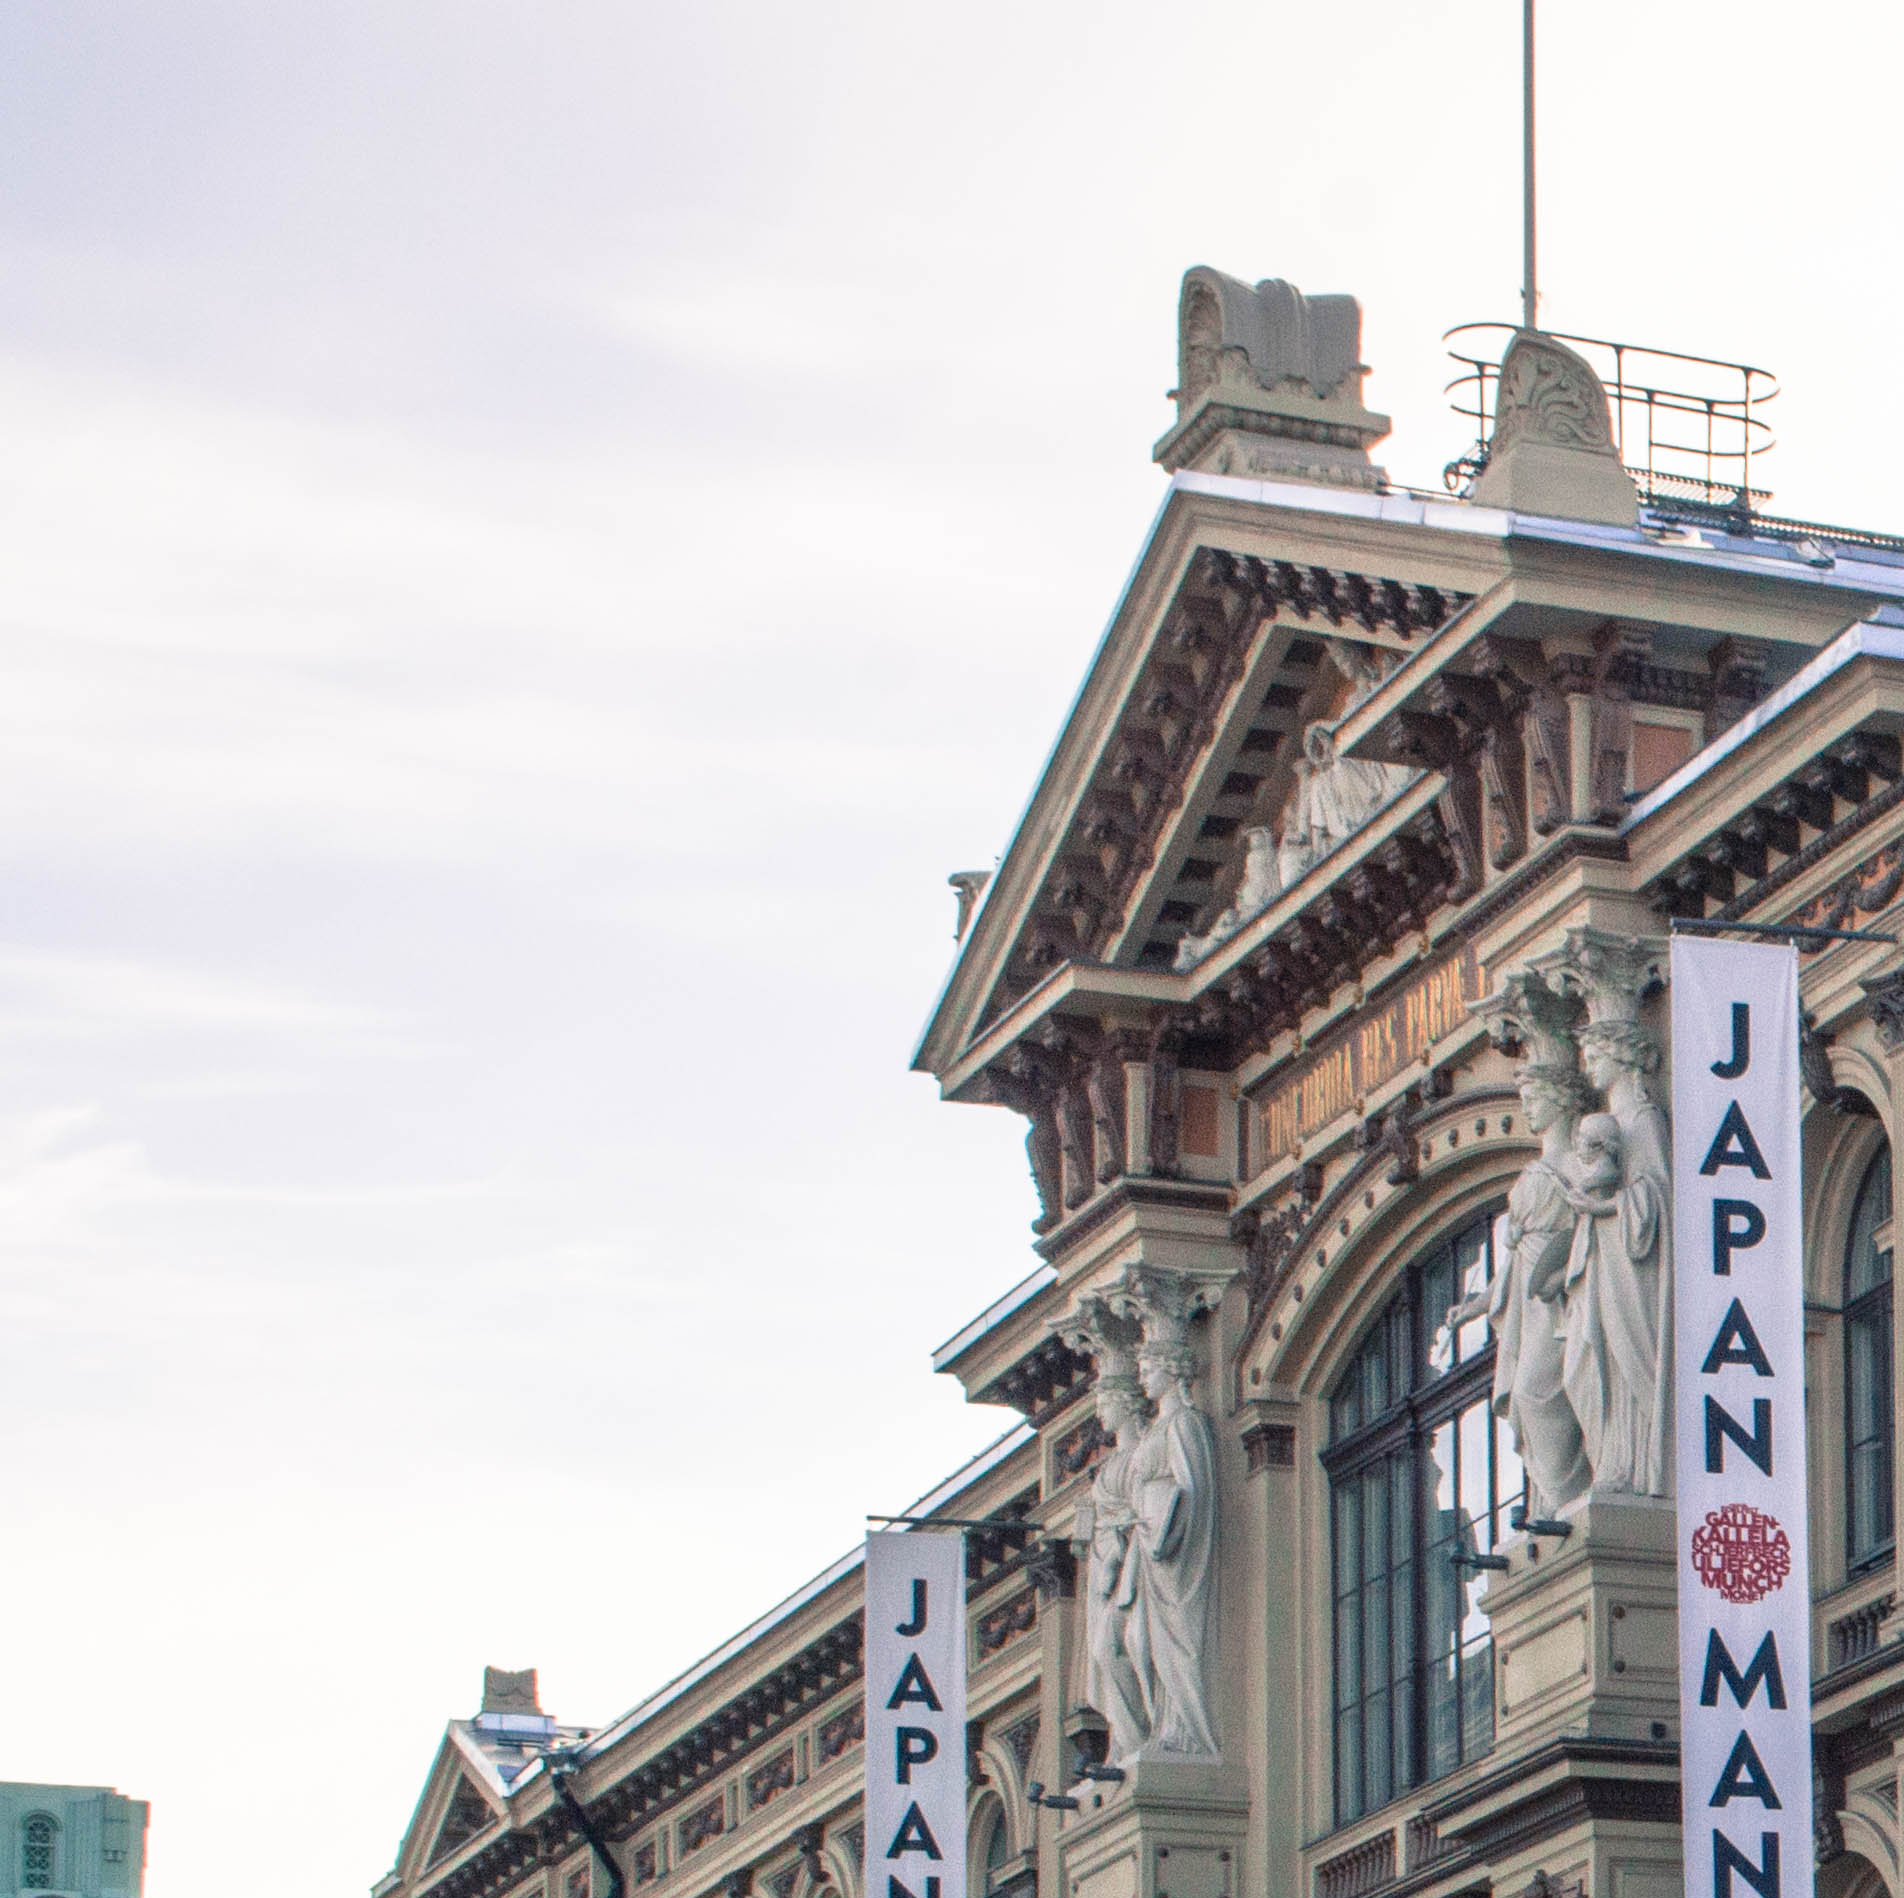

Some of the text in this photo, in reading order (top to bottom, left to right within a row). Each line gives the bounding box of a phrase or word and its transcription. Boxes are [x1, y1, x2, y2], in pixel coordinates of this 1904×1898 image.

[1699, 1002, 1775, 1478] JAPAN
[1692, 1526, 1791, 1550] KALLELA
[1701, 1571, 1783, 1591] MUNCH
